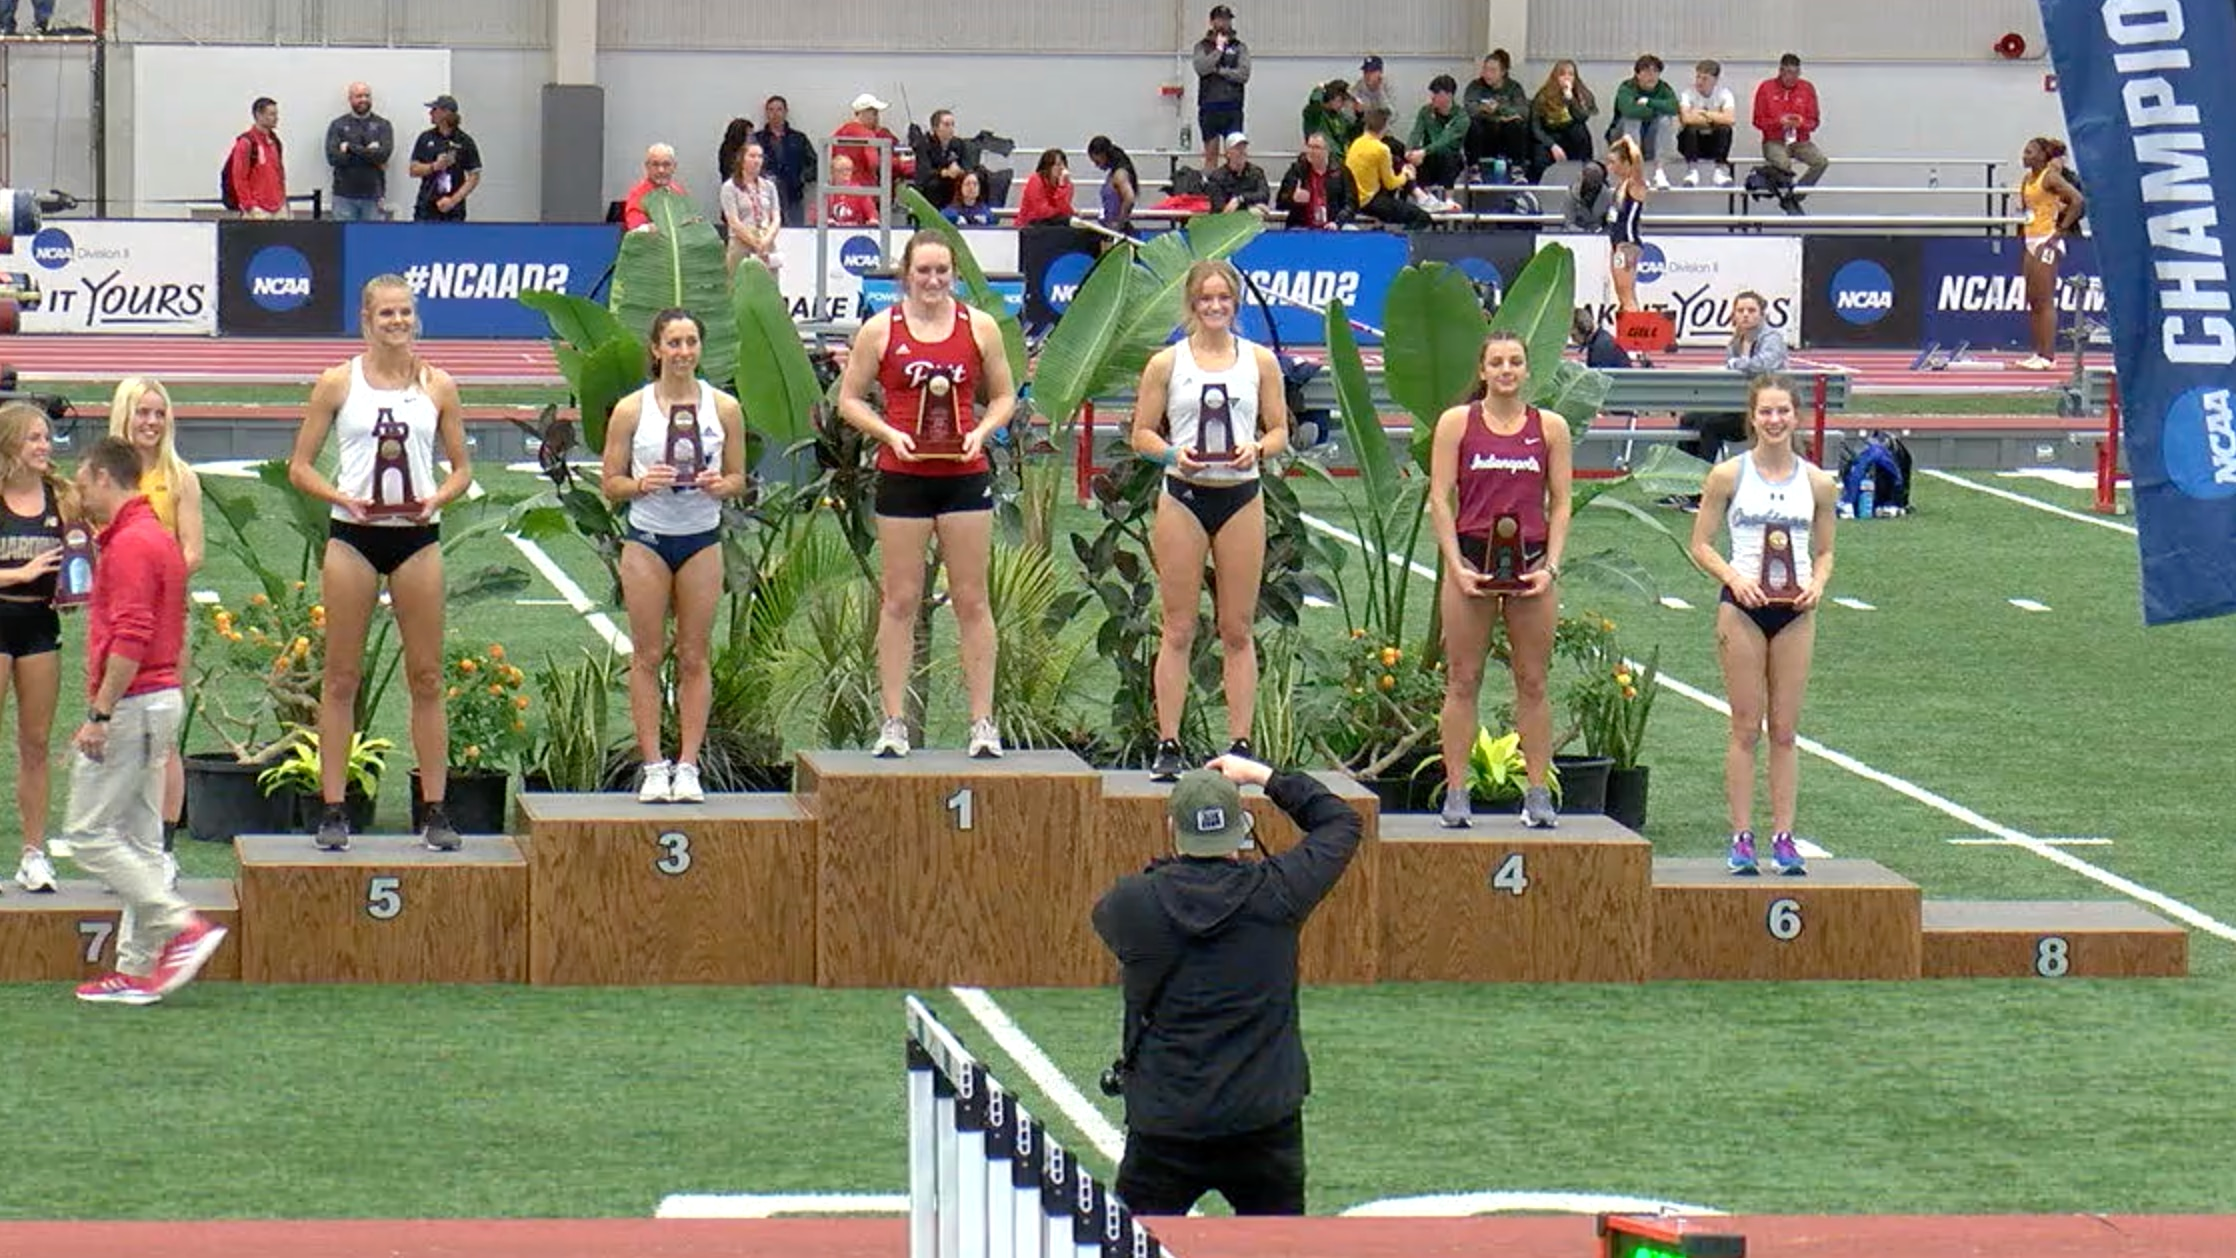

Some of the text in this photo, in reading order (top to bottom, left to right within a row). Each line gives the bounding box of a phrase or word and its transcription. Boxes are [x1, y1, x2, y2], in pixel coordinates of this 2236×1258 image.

[2101, 0, 2236, 365] CHAMPIO
[51, 270, 205, 326] IT YOURS
[253, 277, 310, 295] NCAA
[402, 263, 569, 299] #NCAAD2
[1838, 290, 1893, 309] NCAA
[1672, 284, 1791, 338] YOUS
[2203, 389, 2236, 483] NCAA
[945, 788, 974, 830] 1
[656, 831, 692, 875] 3
[1491, 853, 1529, 896] 4
[367, 876, 403, 920] 5
[1766, 898, 1804, 941] 6
[79, 919, 114, 963] 7
[2034, 936, 2070, 978] 8
